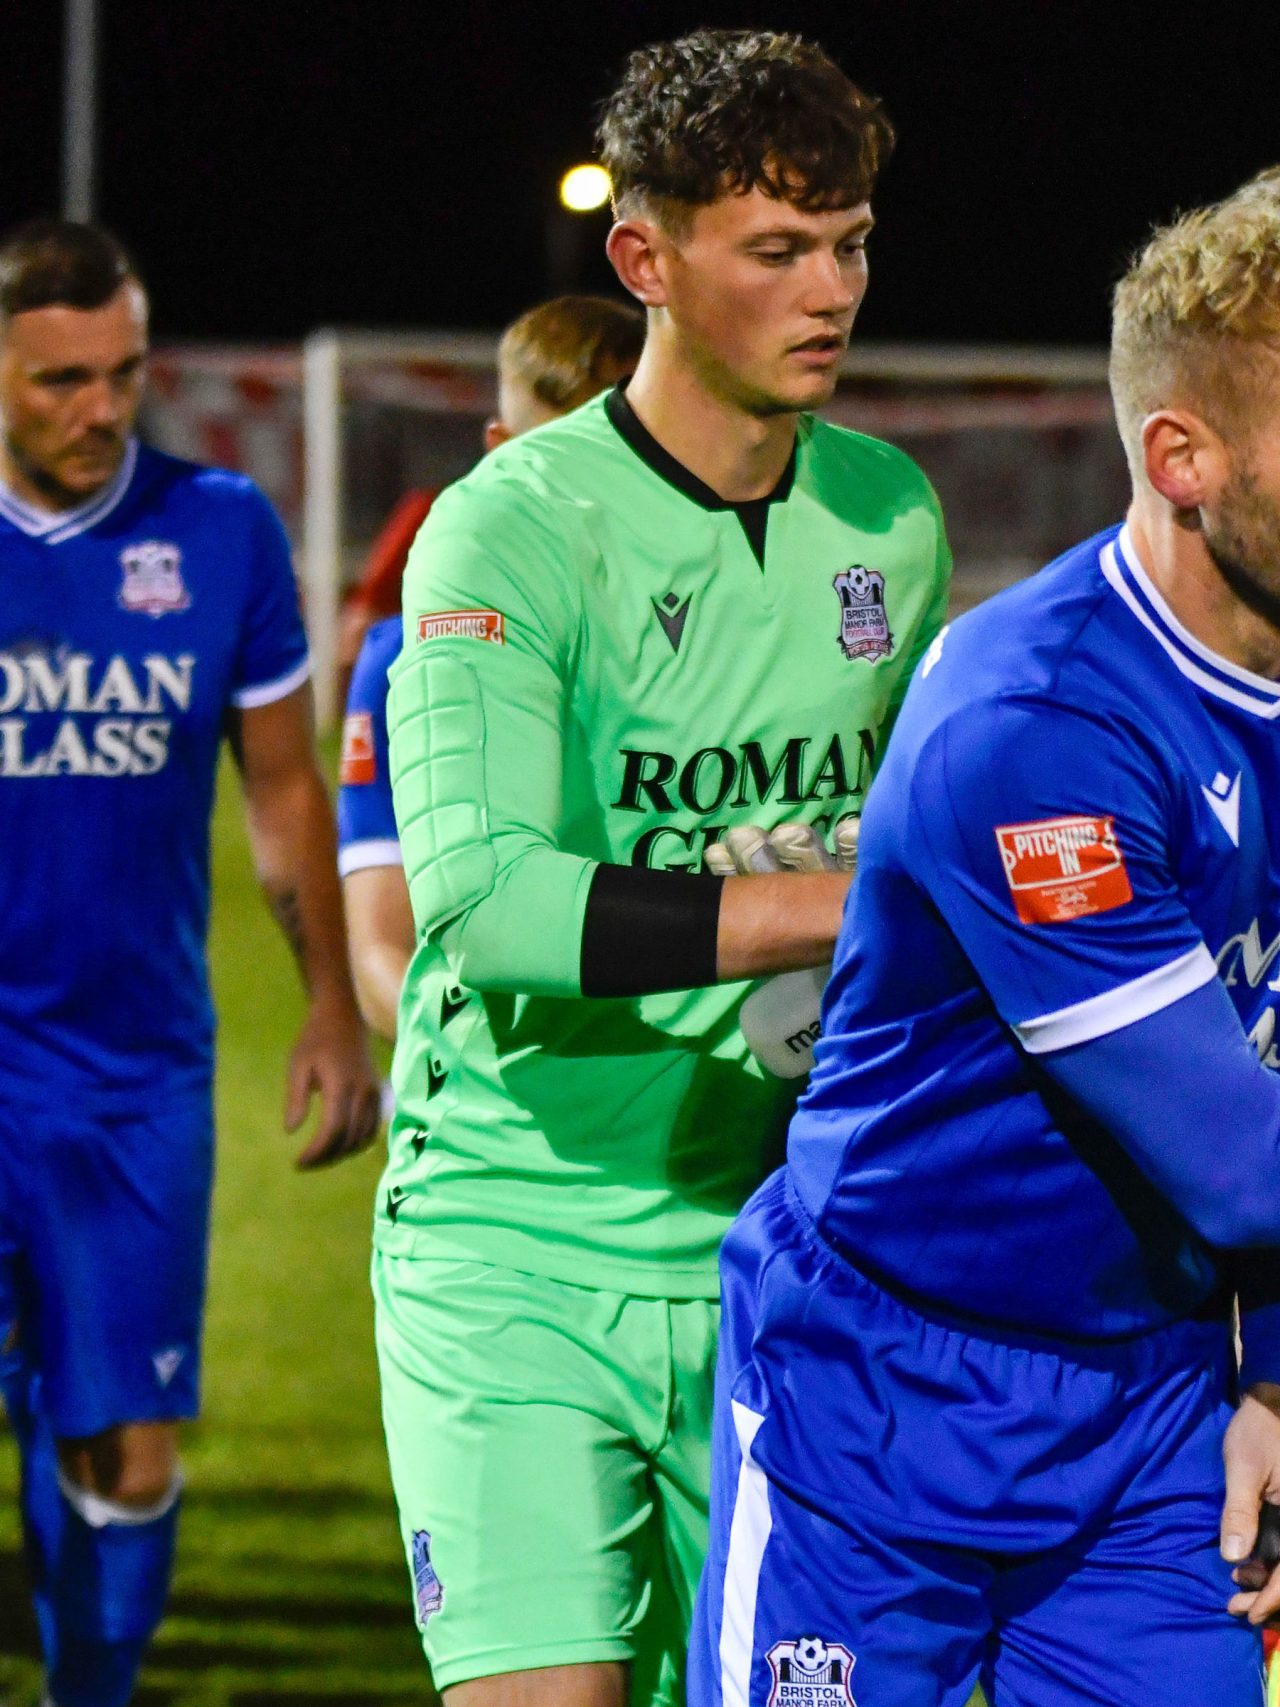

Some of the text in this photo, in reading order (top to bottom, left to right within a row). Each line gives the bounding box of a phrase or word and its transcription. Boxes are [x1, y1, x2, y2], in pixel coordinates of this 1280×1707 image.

[846, 608, 882, 620] BRISTOL
[426, 618, 487, 640] PITCHING
[1014, 824, 1097, 860] PITCHING
[1059, 847, 1081, 876] IN
[780, 1686, 842, 1699] BRISTOL
[776, 1698, 813, 1707] MANOR
